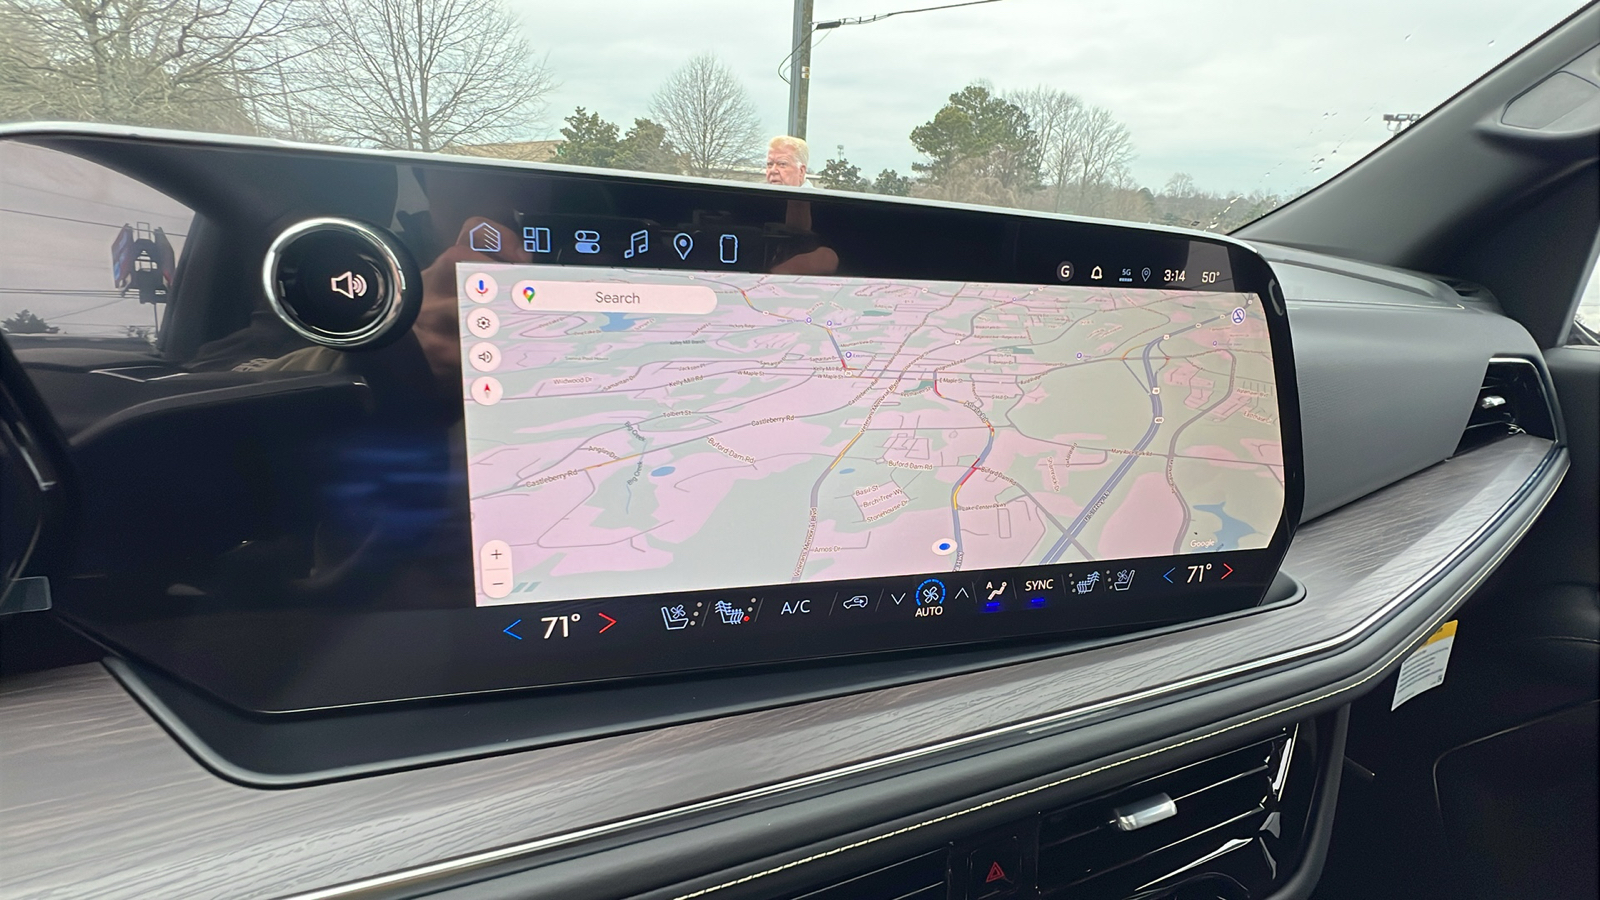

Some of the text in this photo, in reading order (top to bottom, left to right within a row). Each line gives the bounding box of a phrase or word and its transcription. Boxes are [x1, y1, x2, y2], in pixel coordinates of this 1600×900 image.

[1060, 266, 1070, 278] G
[1122, 268, 1132, 276] 5G
[1164, 270, 1186, 282] 3:14
[1201, 271, 1220, 284] 50°
[595, 291, 641, 305] Search
[603, 378, 630, 392] Samaritan
[668, 380, 683, 388] Kelly
[848, 385, 872, 406] Castleberry
[861, 409, 876, 432] Veterans
[873, 389, 890, 412] Memorial
[751, 416, 785, 426] Castleberry
[708, 437, 754, 464] Buford Dam Rd
[526, 468, 578, 488] Castleberry Rd
[980, 466, 999, 477] Buford
[855, 488, 870, 496] Basil
[863, 498, 879, 508] Birch
[880, 494, 893, 502] Tree
[866, 504, 900, 522] Stonehouse
[794, 507, 818, 577] Veterans Memorial Blvd
[1190, 539, 1215, 548] Google
[1187, 563, 1212, 584] 71°
[1025, 578, 1054, 592] SYNC
[780, 600, 811, 615] A/C
[914, 606, 944, 618] AUTO
[540, 613, 581, 639] 71°
